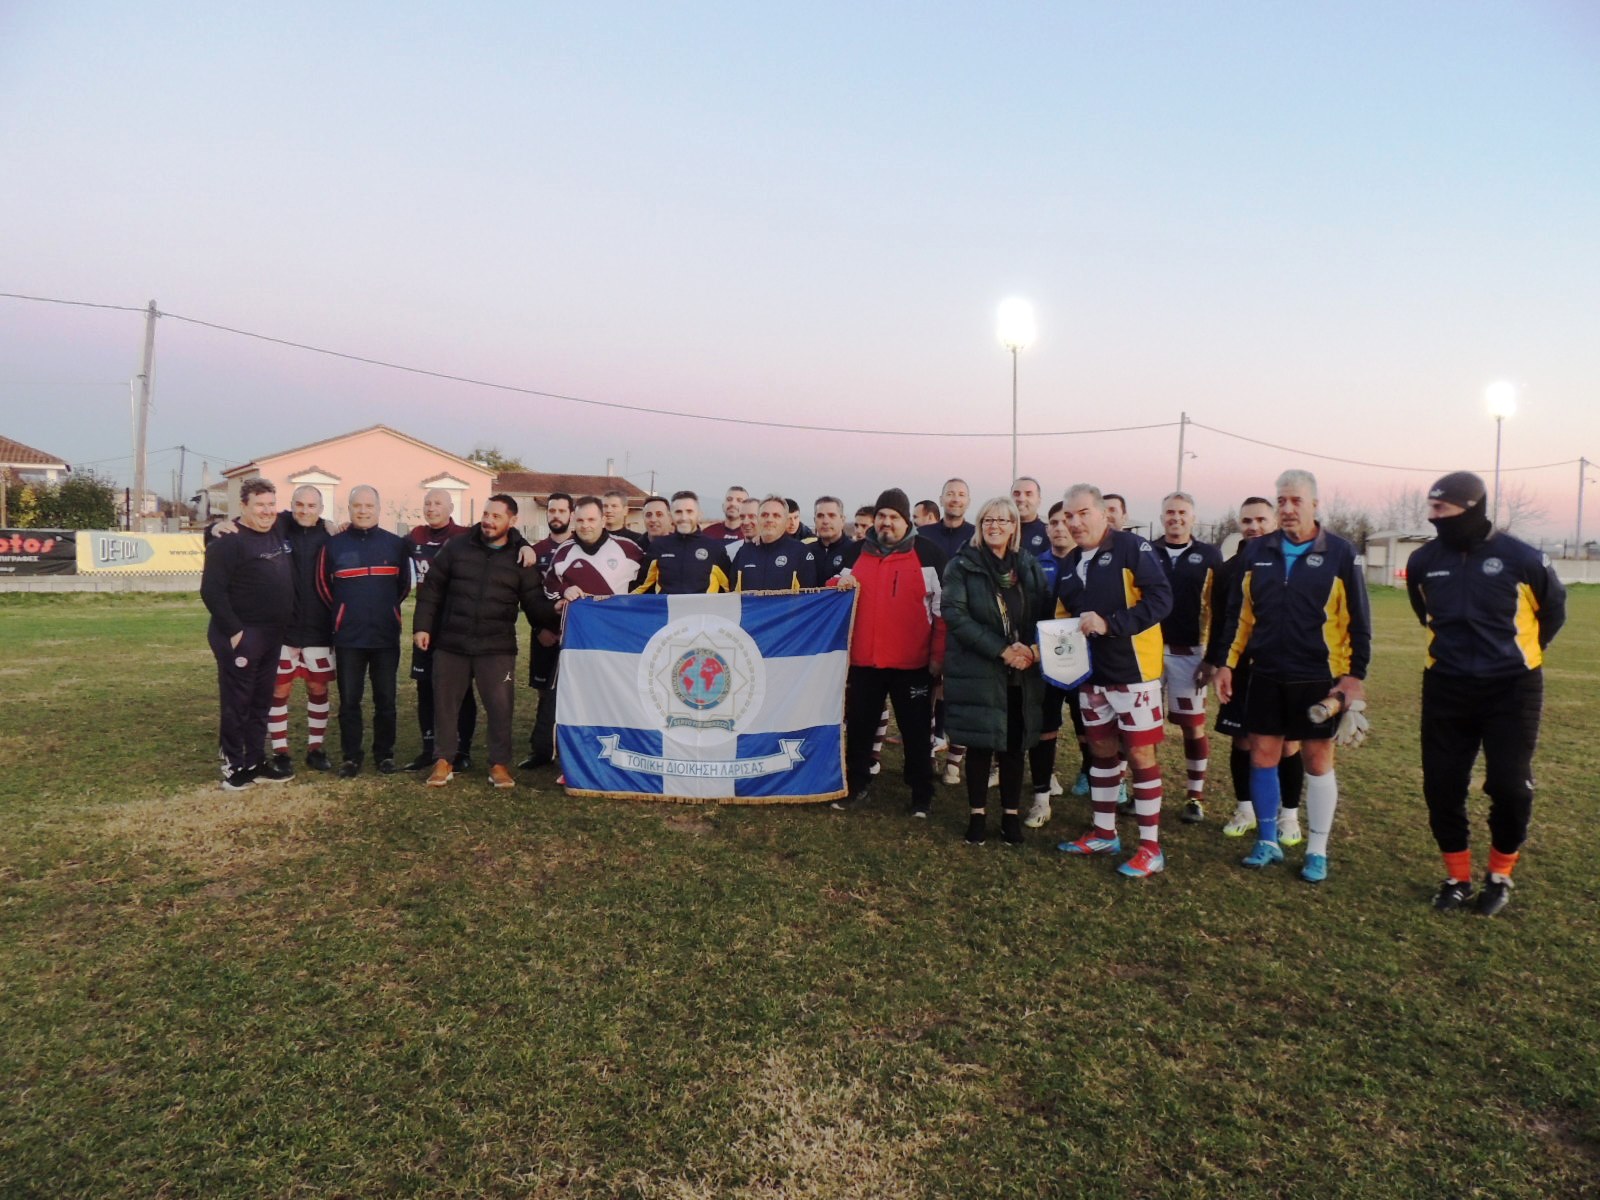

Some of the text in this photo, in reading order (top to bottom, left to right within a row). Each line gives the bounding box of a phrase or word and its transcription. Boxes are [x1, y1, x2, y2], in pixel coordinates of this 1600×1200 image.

[100, 537, 139, 562] DE-TOX
[1134, 690, 1150, 708] 24
[627, 755, 766, 776] ΤΟΠΙΚΗ ΔΙΟΙΚΗΣΗ ΛΑΡΙΣΑΣ
